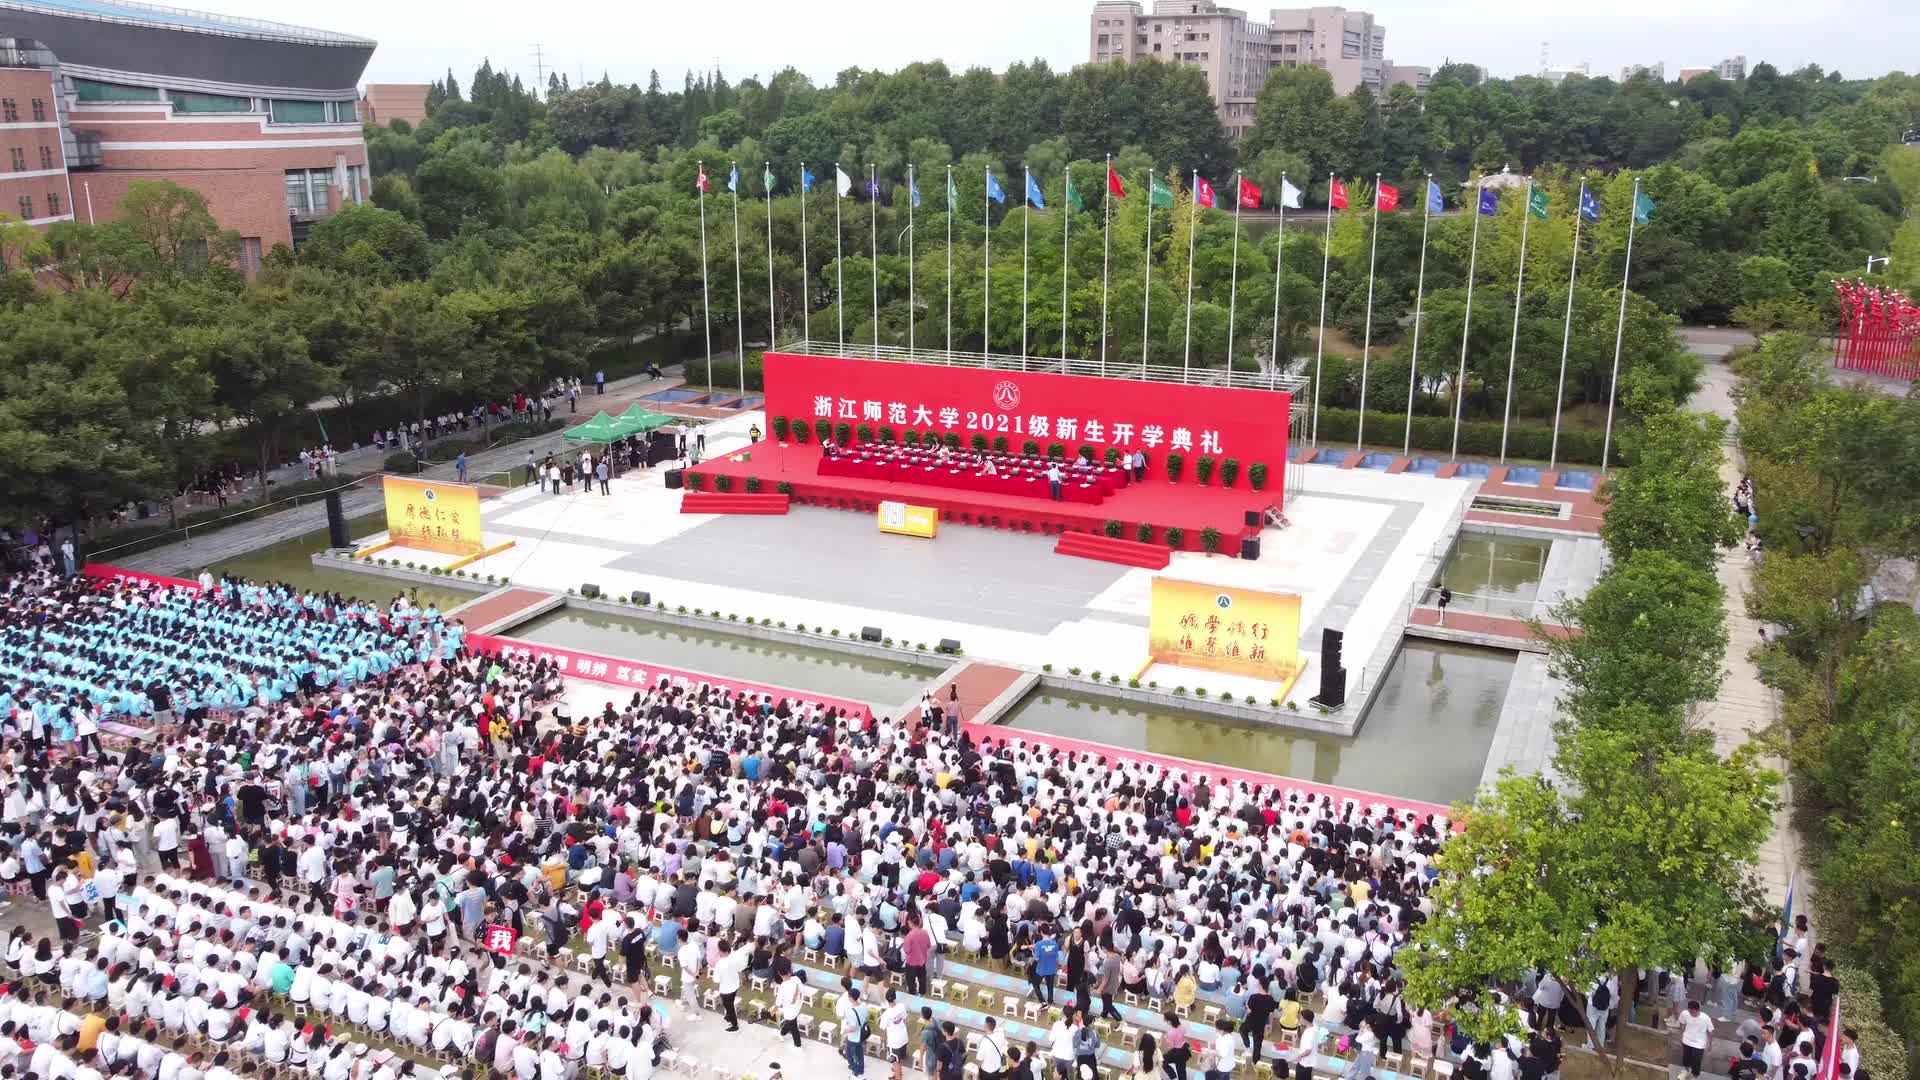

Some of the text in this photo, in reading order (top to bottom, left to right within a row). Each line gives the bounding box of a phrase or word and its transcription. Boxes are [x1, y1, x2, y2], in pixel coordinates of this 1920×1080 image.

[814, 395, 1224, 455] 浙江师范大学2021级新生开学典礼
[576, 659, 608, 677] 明辨
[616, 666, 648, 684] 笃实
[491, 929, 513, 951] 我
